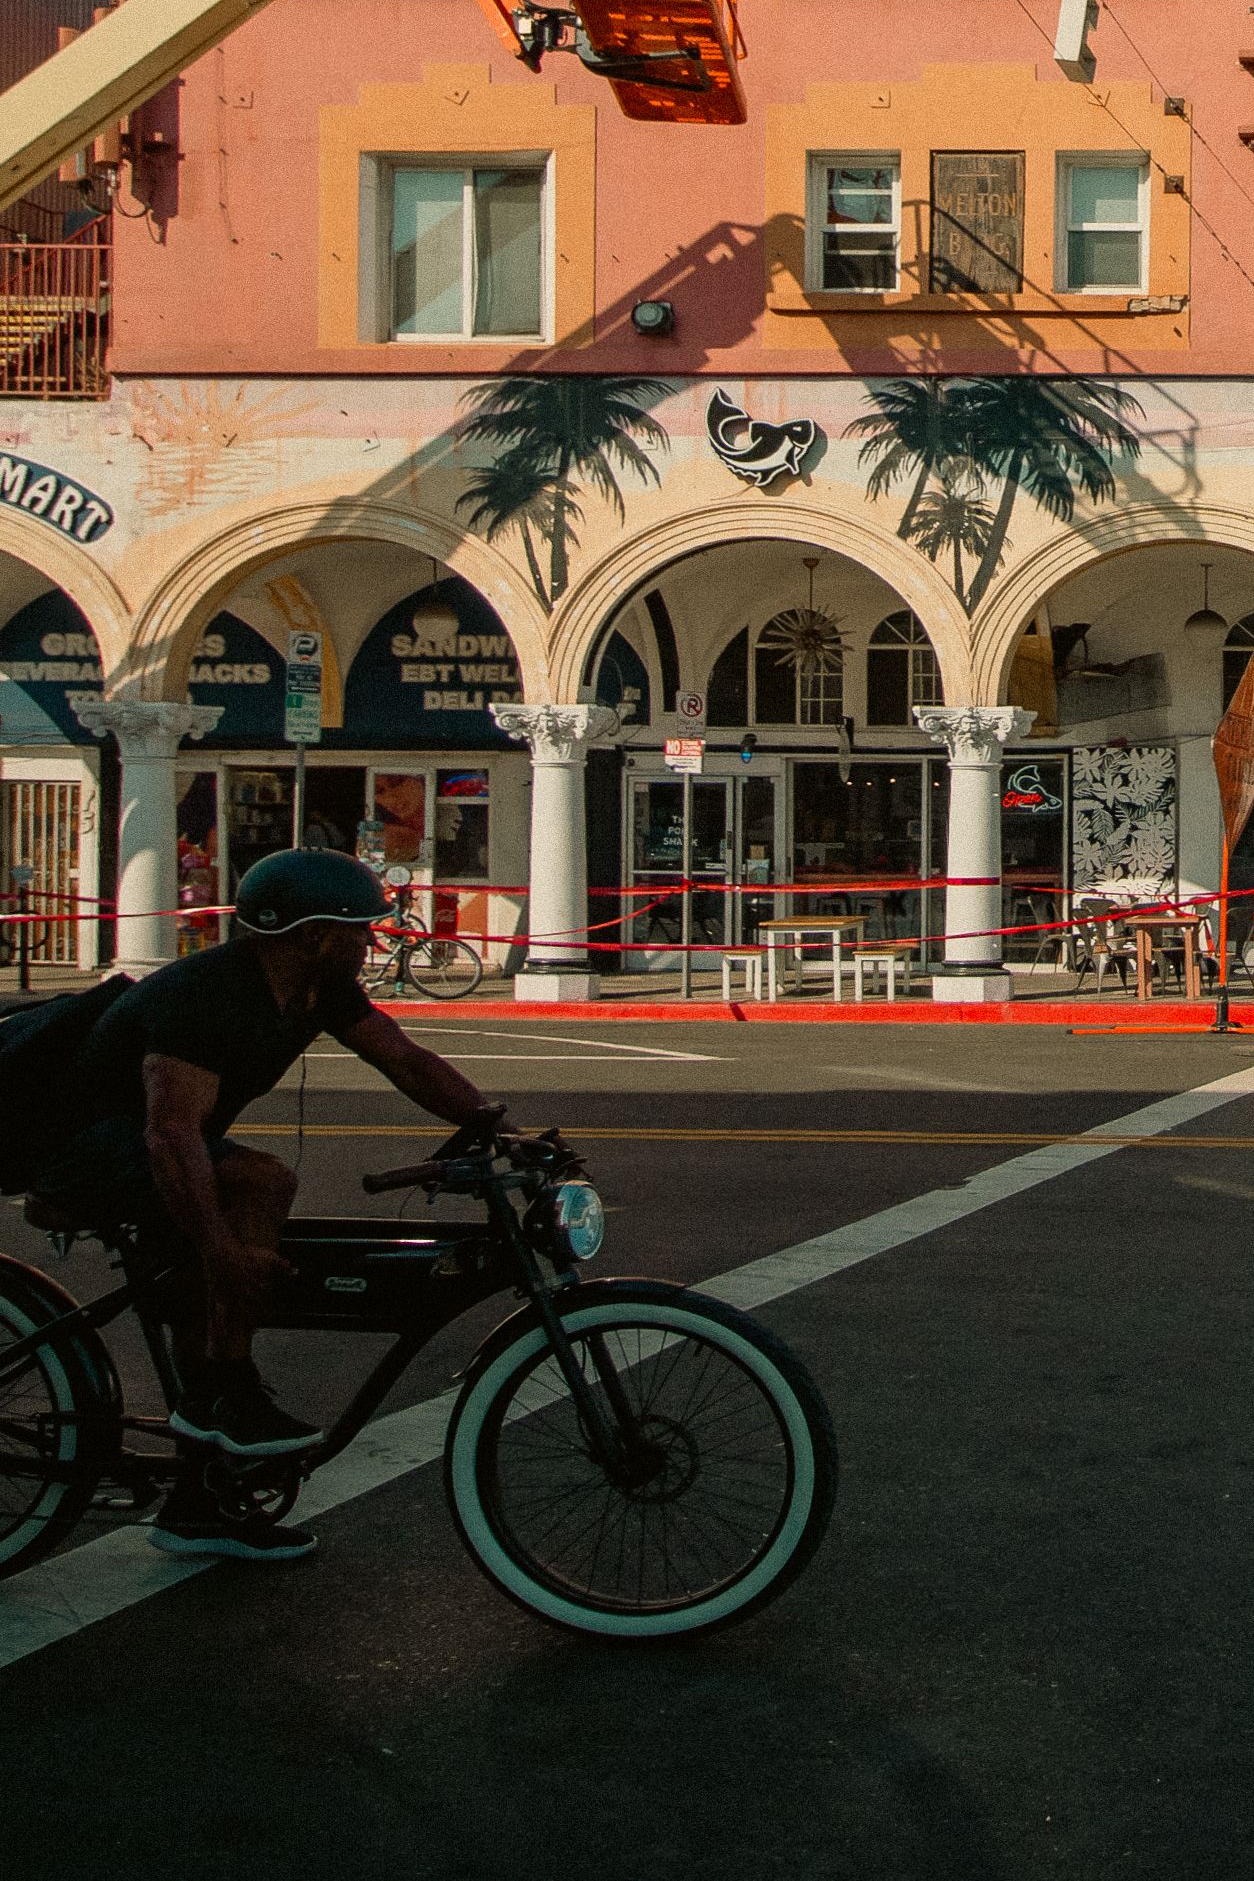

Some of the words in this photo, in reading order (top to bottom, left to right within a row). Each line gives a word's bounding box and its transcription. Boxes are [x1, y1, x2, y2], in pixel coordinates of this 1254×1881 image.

[0, 456, 110, 540] MART
[401, 664, 454, 682] EBT
[423, 691, 484, 710] DELI
[663, 838, 698, 846] SHAK
